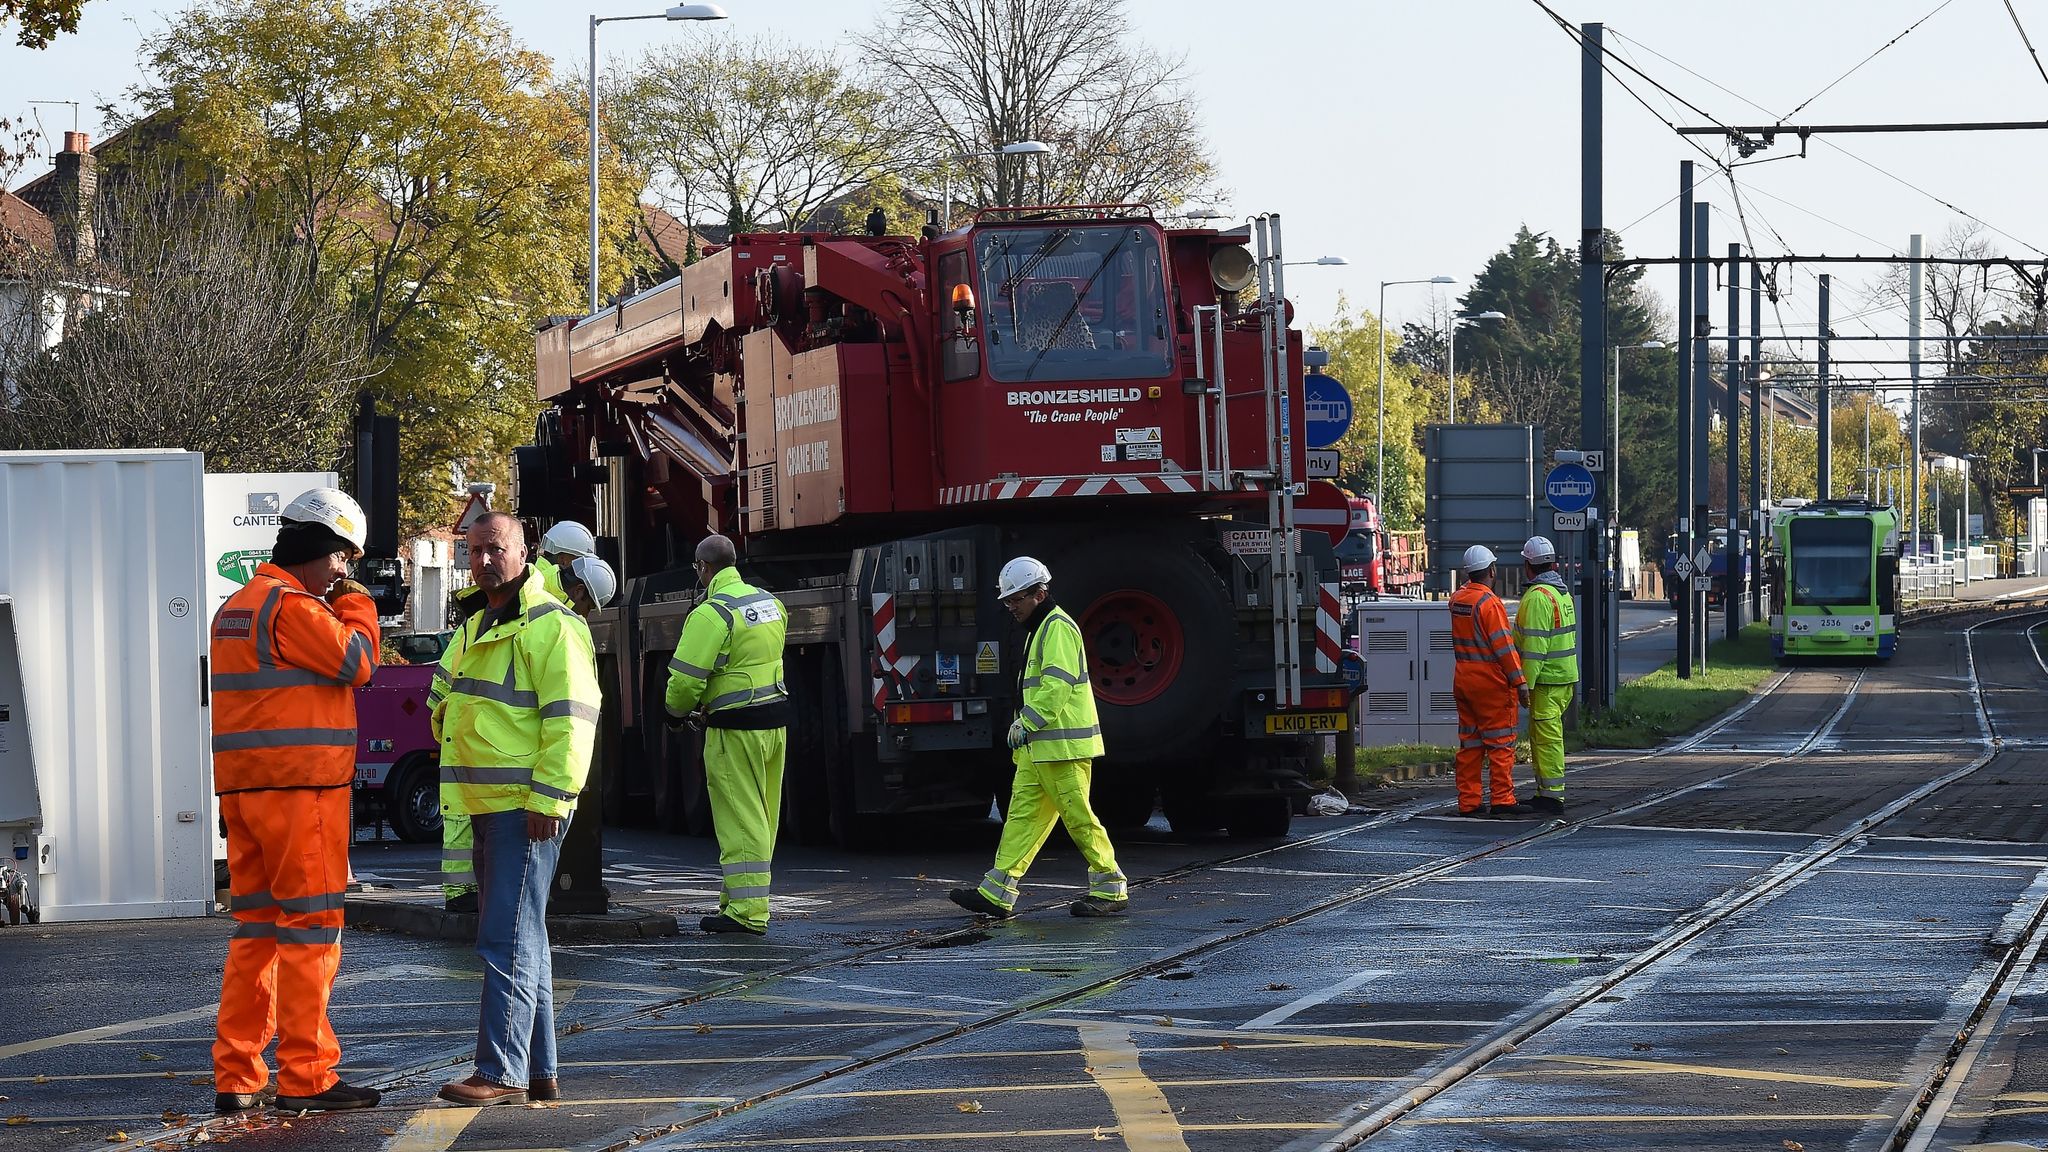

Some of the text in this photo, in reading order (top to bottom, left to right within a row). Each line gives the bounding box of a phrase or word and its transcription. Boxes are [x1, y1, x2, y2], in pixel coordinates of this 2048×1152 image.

[1007, 388, 1141, 405] BRONZESHIELD
[775, 384, 838, 432] BRONZESHIELD
[1024, 407, 1124, 424] "The Crane People"
[786, 440, 830, 477] CRANE HIRE
[1307, 456, 1331, 471] nly
[232, 515, 282, 527] CANTEE
[1557, 516, 1581, 527] Only
[219, 553, 239, 566] PLANT
[222, 562, 236, 572] HIRE
[1677, 562, 1691, 572] 30
[1821, 619, 1841, 627] 2536
[1273, 714, 1338, 731] LK10 ERV
